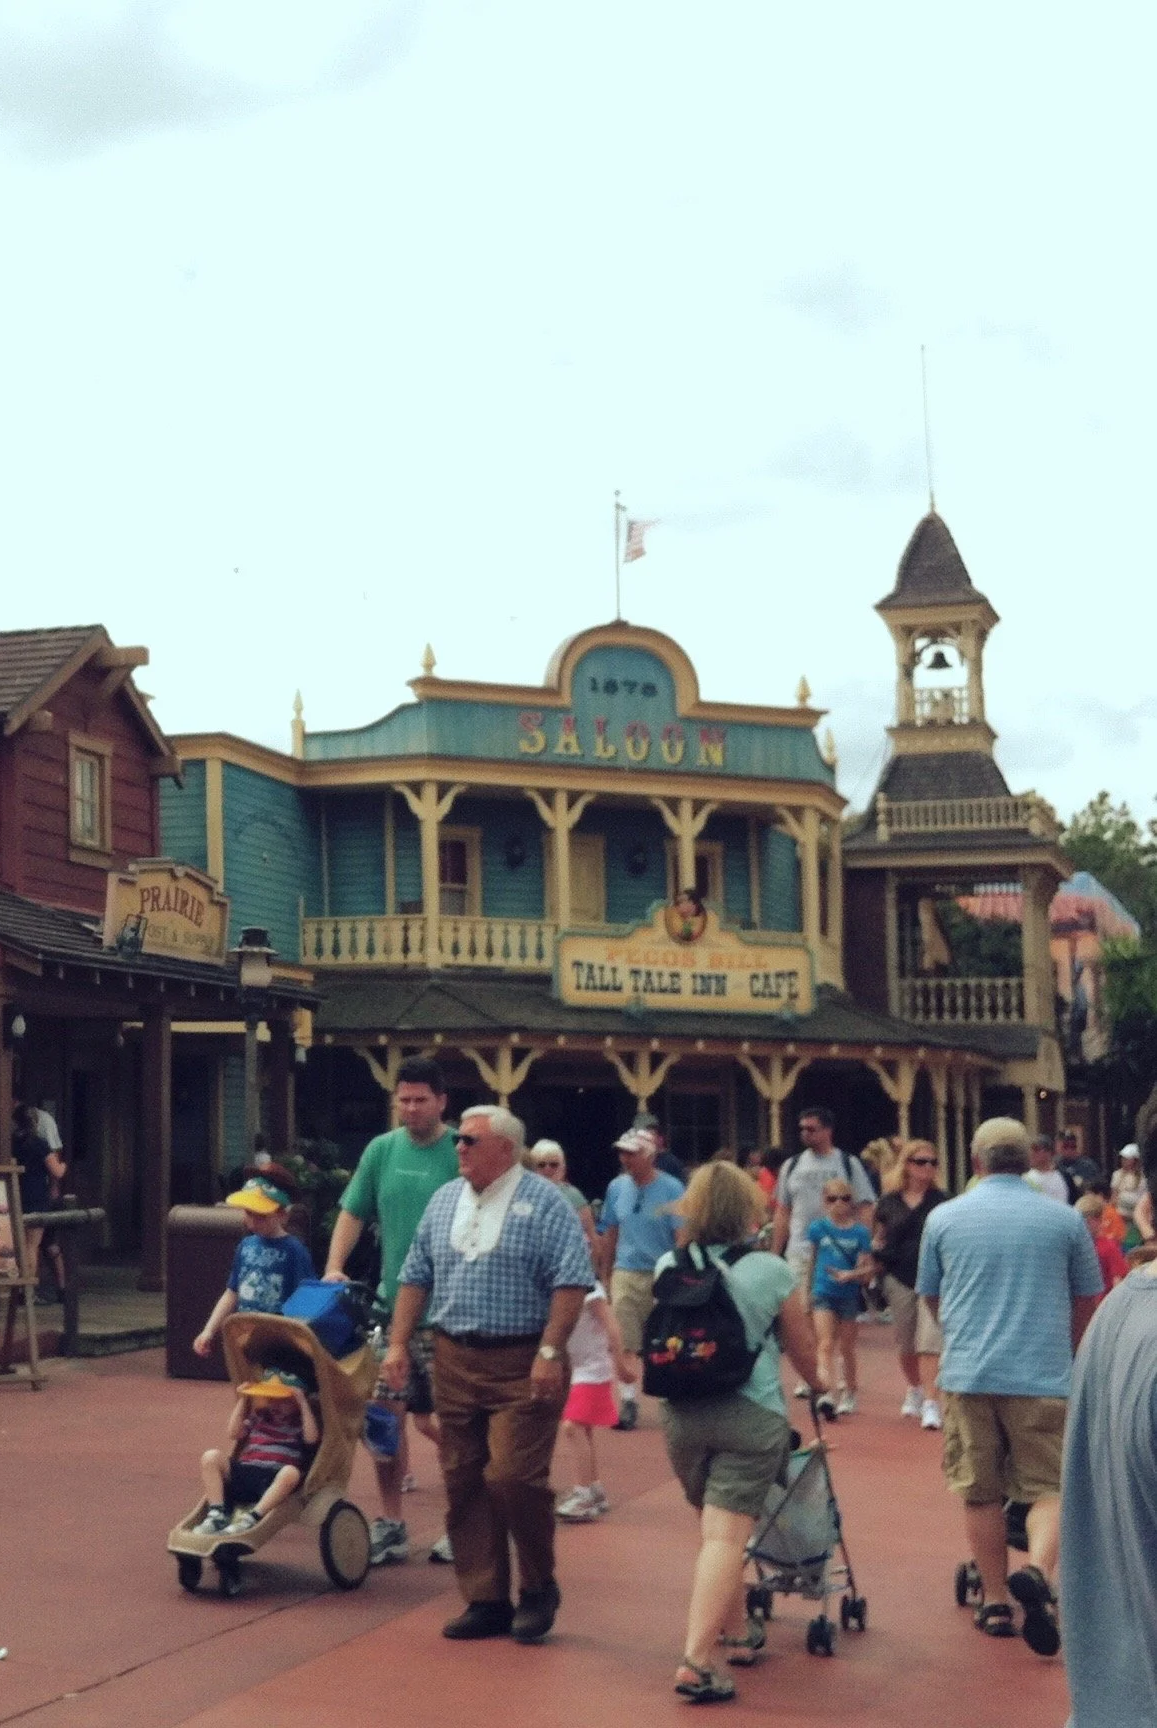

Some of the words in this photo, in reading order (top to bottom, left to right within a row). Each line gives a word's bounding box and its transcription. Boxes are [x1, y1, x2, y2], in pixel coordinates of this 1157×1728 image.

[519, 711, 727, 768] SALOON
[140, 885, 205, 928] PRAIRIE
[572, 959, 623, 992] TALL
[630, 968, 682, 995] TALE
[691, 973, 727, 996] INN
[750, 970, 798, 999] CAFE
